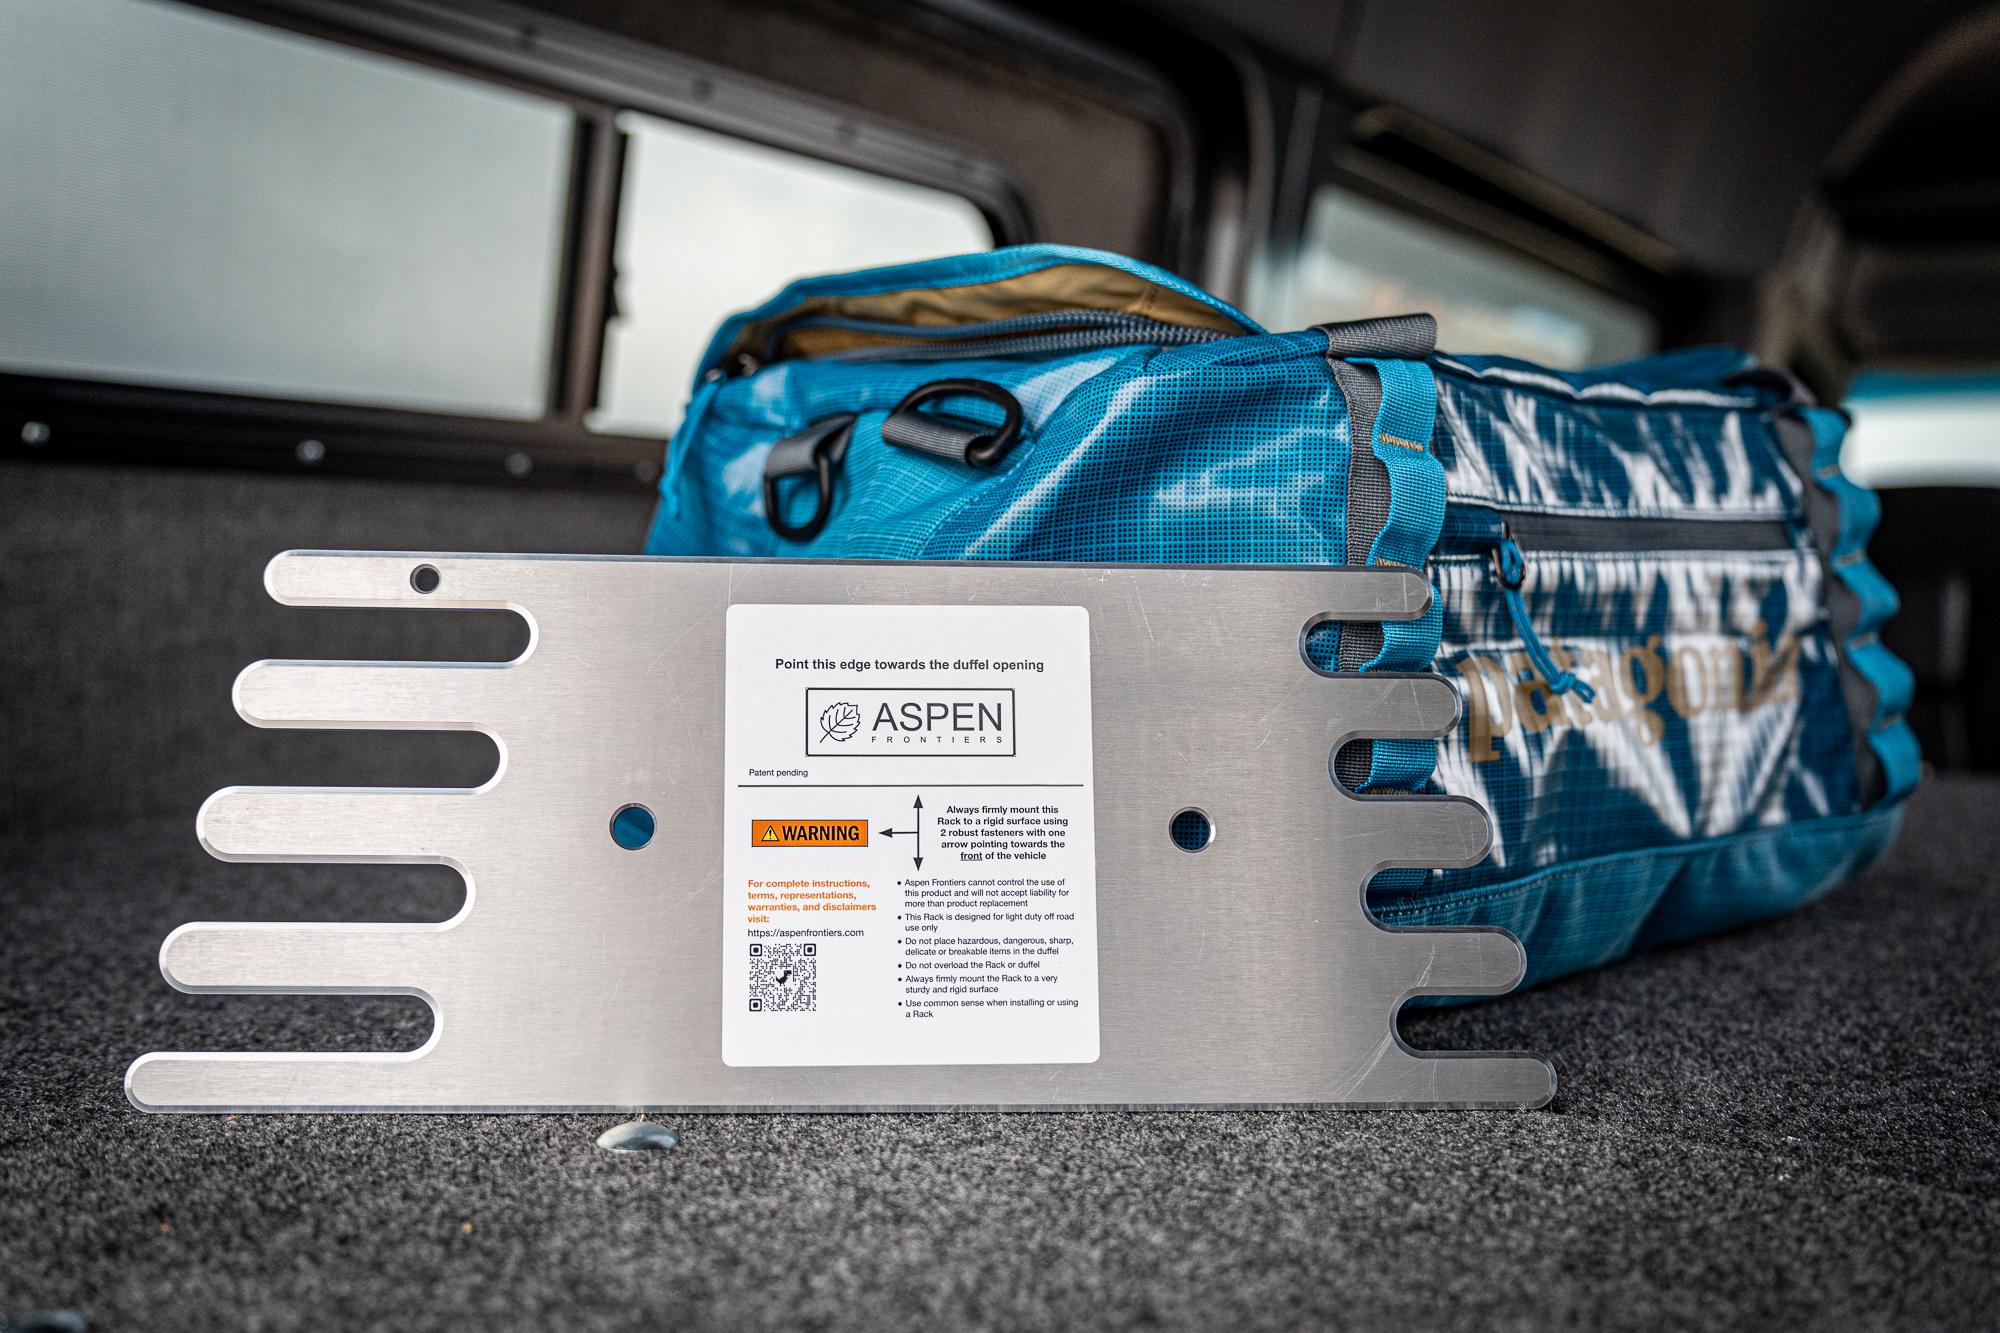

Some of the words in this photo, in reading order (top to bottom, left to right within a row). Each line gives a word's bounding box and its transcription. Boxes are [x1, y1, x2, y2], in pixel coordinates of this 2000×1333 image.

[775, 658, 809, 670] Point
[812, 658, 836, 670] this
[840, 659, 871, 673] edge
[874, 659, 926, 670] towards
[929, 659, 950, 670] the
[953, 659, 989, 670] duffel
[993, 659, 1044, 673] opening
[872, 702, 1002, 732] ASPEN
[871, 736, 1003, 744] FRONTIERS
[749, 768, 775, 777] Patent
[776, 769, 809, 778] pending
[946, 805, 980, 816] Always
[981, 805, 1008, 816] firmly
[1010, 806, 1040, 814] mount
[1041, 805, 1059, 814] this
[937, 817, 961, 826] Rack
[963, 817, 973, 826] to
[975, 818, 981, 826] a
[983, 817, 1004, 827] rigid
[1006, 817, 1041, 826] surface
[1043, 817, 1069, 827] using
[782, 825, 860, 841] WARNING
[940, 828, 947, 837] 2
[948, 828, 979, 837] robust
[980, 828, 1024, 837] fasteners
[1026, 828, 1046, 837] with
[970, 840, 1008, 851] pointing
[1010, 840, 1048, 848] towards
[1050, 840, 1066, 849] the
[960, 851, 983, 862] front
[985, 851, 995, 860] of
[996, 851, 1012, 860] the
[1014, 851, 1047, 860] vehicle
[748, 879, 764, 888] For
[765, 880, 810, 890] complete
[812, 880, 870, 888] instructions,
[904, 878, 930, 888] Aspen
[932, 878, 966, 887] Frontiers
[997, 878, 1025, 886] control
[1057, 878, 1065, 886] of
[747, 891, 778, 900] terms,
[780, 891, 857, 901] representations,
[904, 889, 920, 897] this
[921, 889, 952, 899] product
[953, 889, 969, 897] and
[970, 889, 984, 897] will
[985, 889, 999, 897] not
[1000, 889, 1028, 898] accept
[1029, 889, 1057, 898] liability
[1058, 889, 1070, 897] for
[747, 903, 800, 912] warranties,
[802, 903, 821, 911] and
[822, 903, 877, 911] disclaimers
[927, 900, 945, 908] than
[947, 900, 978, 909] product
[979, 899, 1028, 909] replacement
[747, 915, 769, 923] visit:
[905, 913, 922, 921] This
[923, 913, 945, 921] Rack
[954, 913, 991, 923] designed
[993, 913, 1004, 921] for
[1005, 913, 1023, 922] light
[1024, 913, 1043, 922] duty
[1044, 912, 1055, 921] off
[1056, 913, 1075, 921] road
[747, 928, 864, 939] https://aspenfrontiers.com
[921, 924, 938, 933] only
[905, 937, 917, 945] Do
[934, 937, 956, 947] place
[957, 937, 1001, 945] hazardous,
[1002, 937, 1047, 947] dangerous,
[1049, 937, 1074, 946] sharp,
[905, 948, 937, 956] delicate
[948, 947, 988, 956] breakable
[989, 947, 1011, 955] items
[1022, 947, 1035, 955] the
[1036, 947, 1059, 955] duffel
[905, 961, 917, 970] Do
[934, 961, 969, 969] overload
[970, 961, 984, 969] the
[985, 961, 1006, 969] Rack
[1017, 960, 1040, 969] duffel
[905, 975, 934, 985] Always
[935, 975, 958, 985] firmly
[959, 975, 985, 983] mount
[987, 974, 1000, 983] the
[1001, 974, 1022, 983] Rack
[1041, 975, 1058, 984] very
[905, 986, 931, 996] sturdy
[932, 985, 948, 994] and
[949, 985, 967, 995] rigid
[969, 985, 999, 993] surface
[905, 999, 922, 1008] Use
[986, 999, 1008, 1007] when
[1010, 998, 1045, 1008] installing
[1057, 999, 1079, 1008] using
[913, 1010, 934, 1018] Rack
